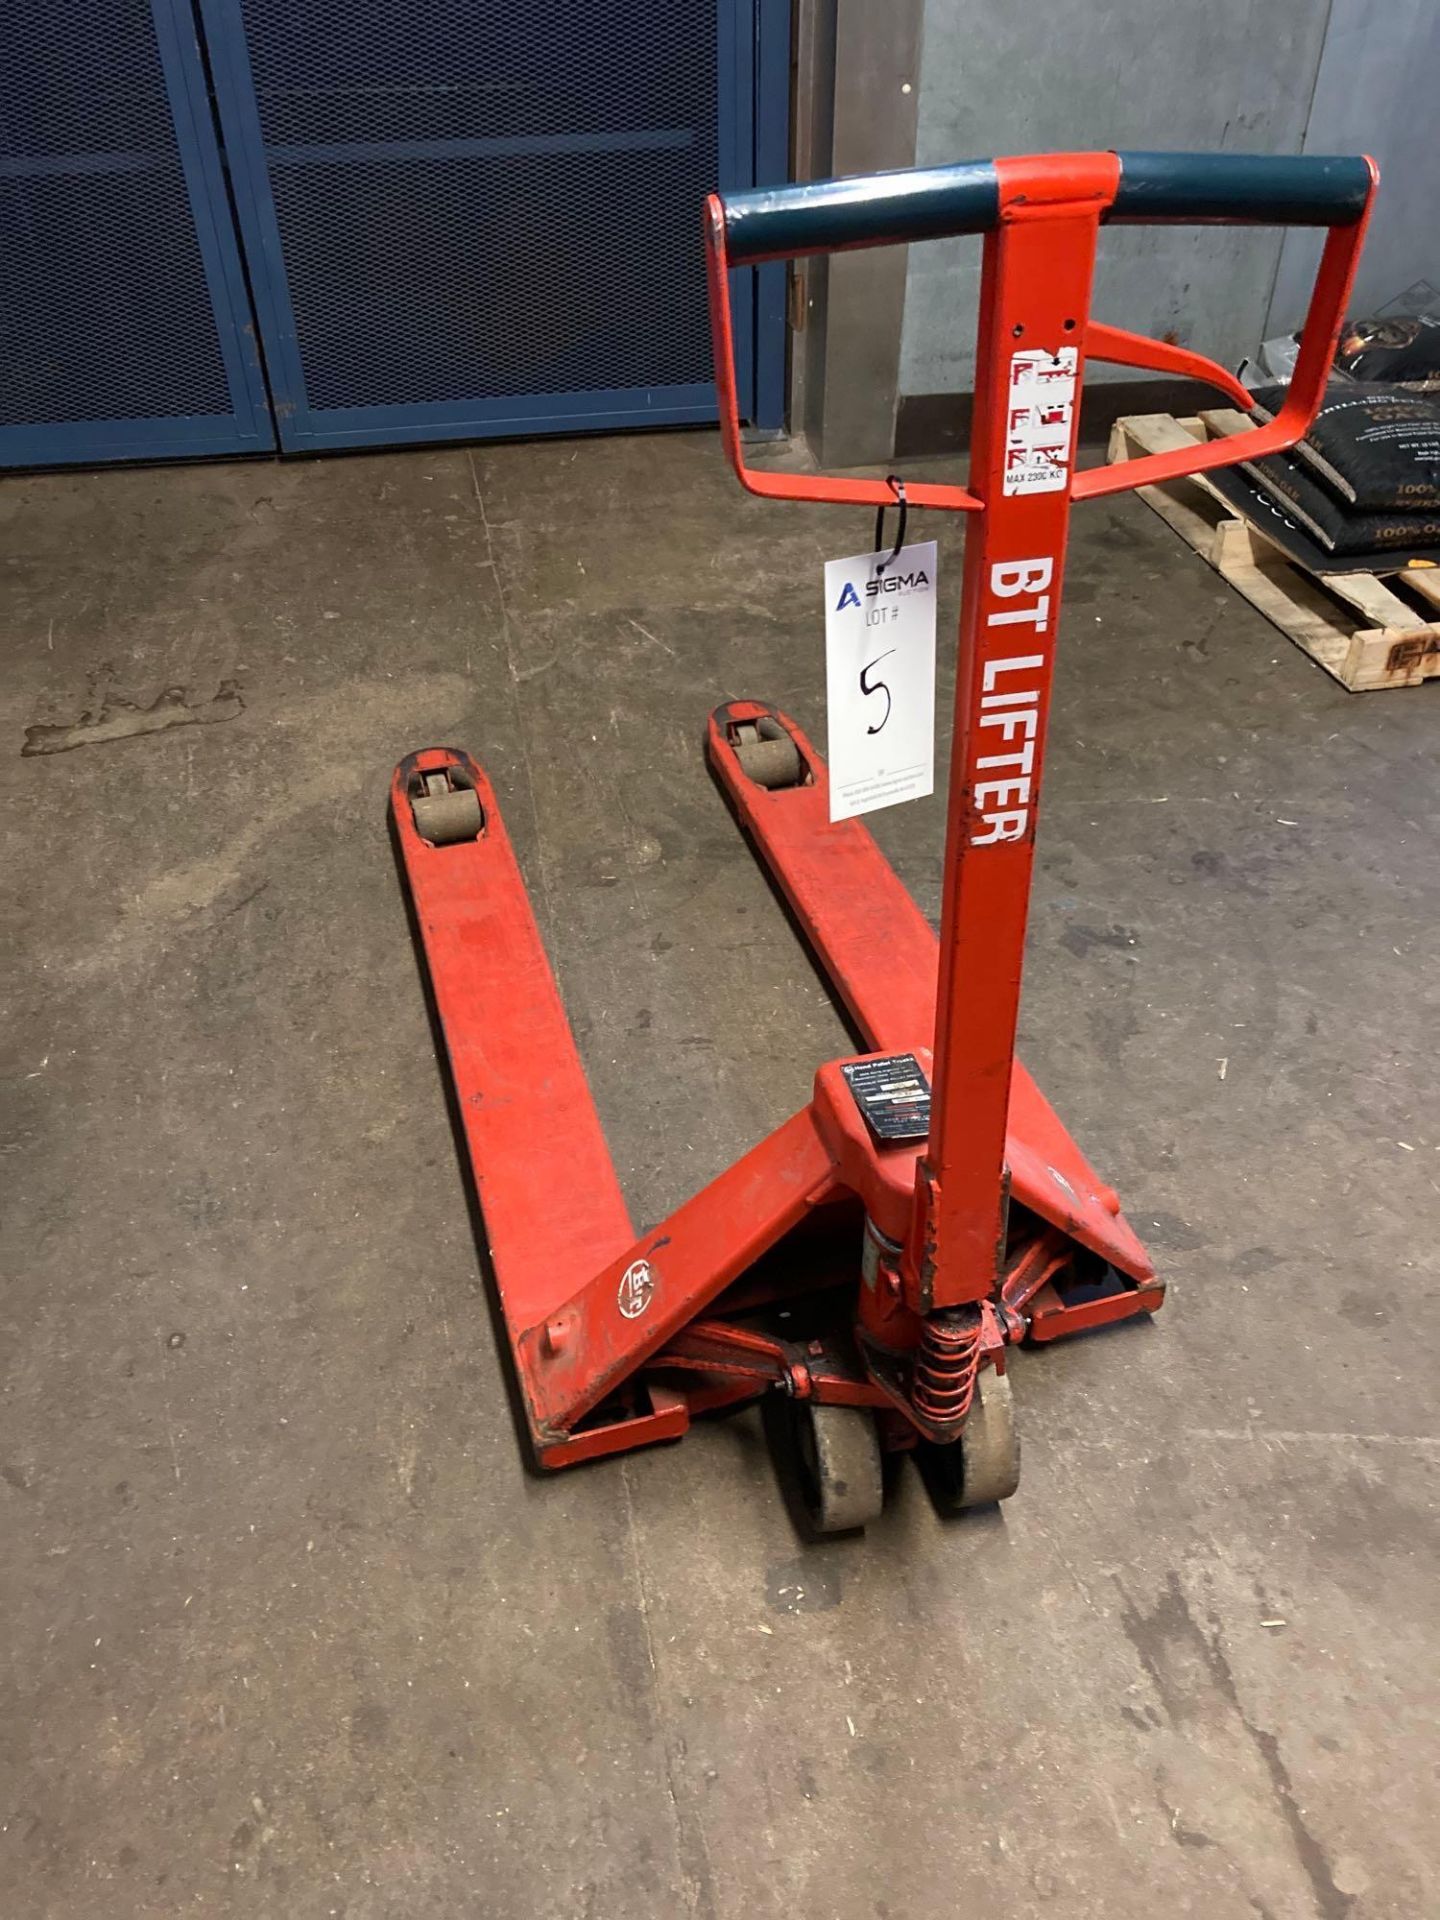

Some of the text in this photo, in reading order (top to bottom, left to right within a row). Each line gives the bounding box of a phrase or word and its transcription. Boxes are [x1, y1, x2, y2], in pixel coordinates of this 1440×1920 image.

[1006, 473, 1025, 483] MAX
[865, 570, 929, 597] SIGMA
[865, 607, 888, 627] LOT
[860, 649, 896, 735] 5
[969, 557, 1054, 846] BT LIFTER
